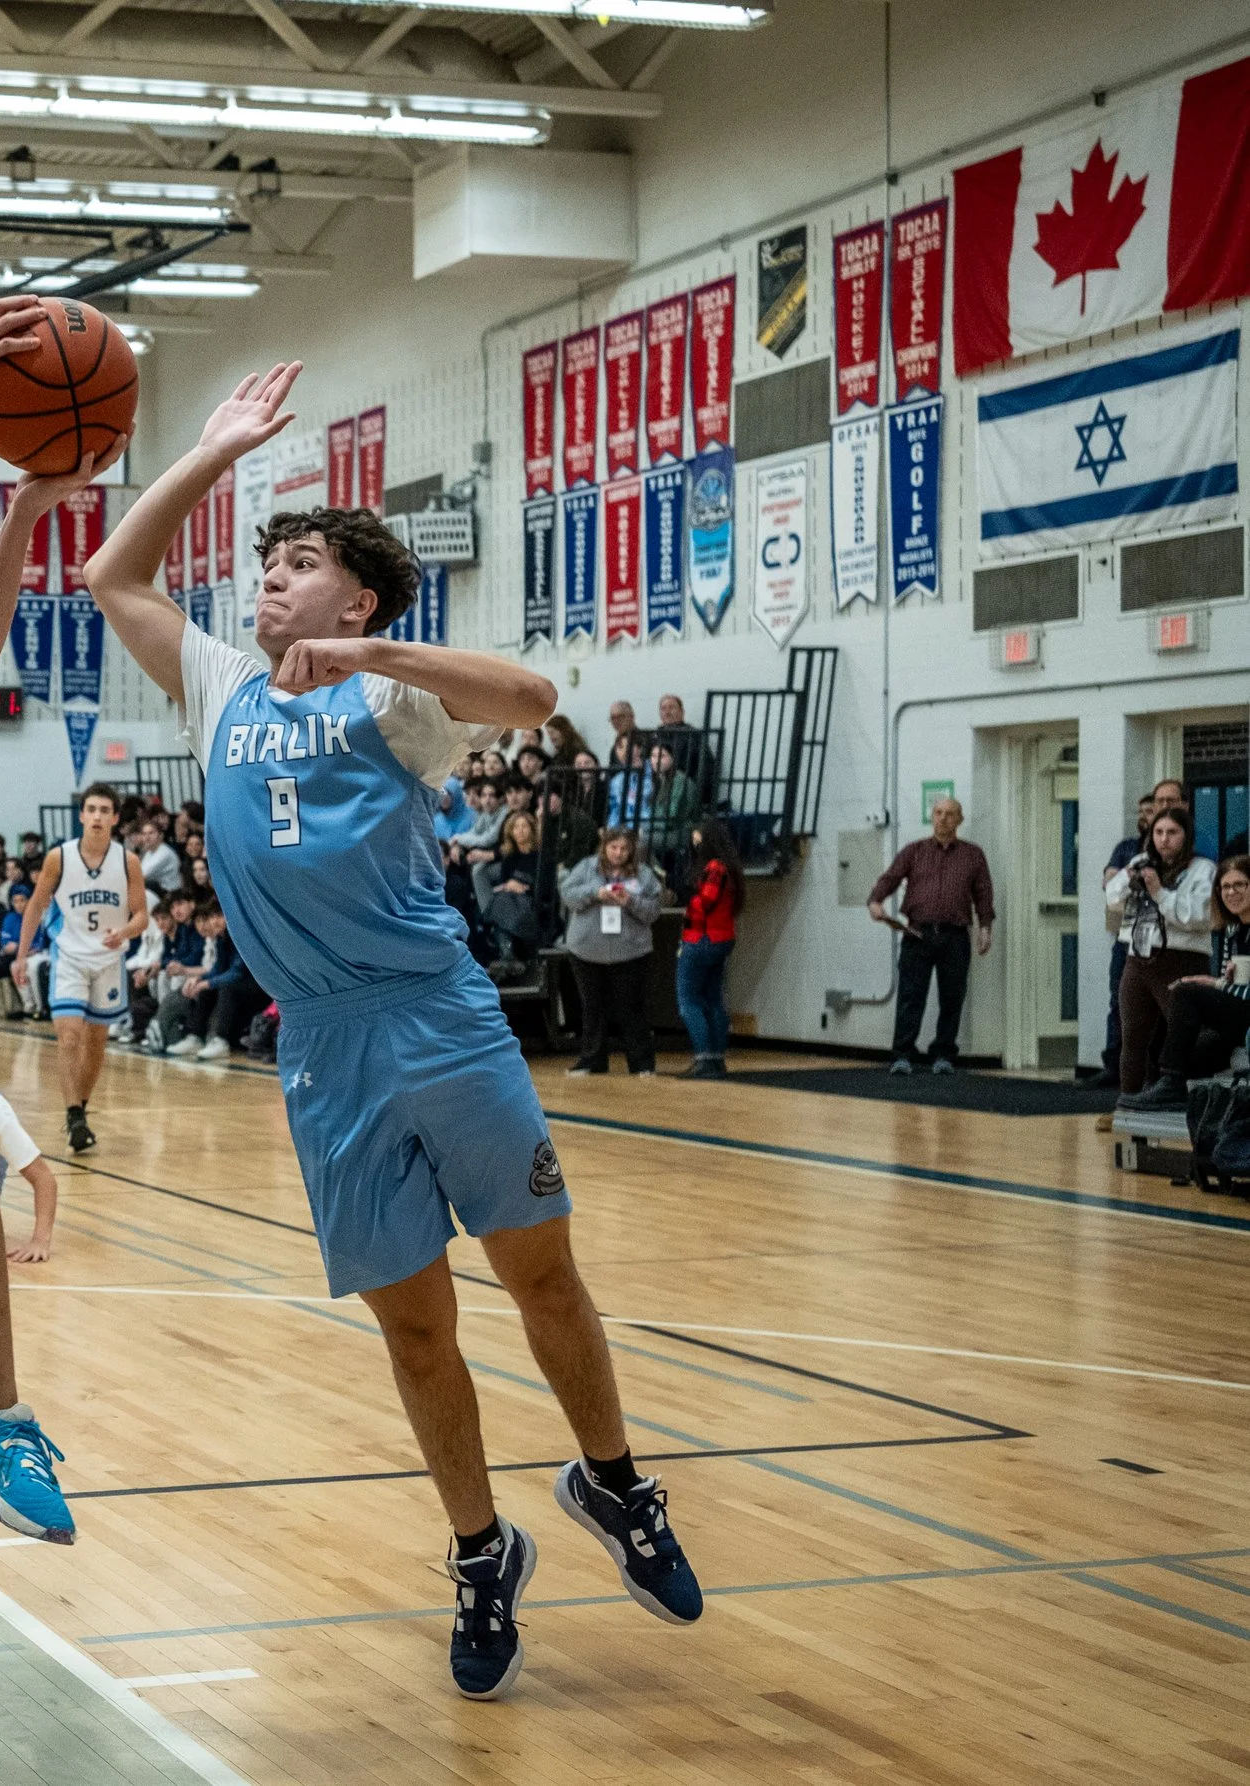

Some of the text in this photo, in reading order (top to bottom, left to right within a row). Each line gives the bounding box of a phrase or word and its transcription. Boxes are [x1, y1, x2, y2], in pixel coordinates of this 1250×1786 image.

[851, 277, 865, 363] HOCKEY
[910, 442, 924, 536] GOLF
[225, 712, 352, 768] BIALIK
[265, 776, 302, 849] 9
[68, 889, 120, 908] TIGERS
[87, 911, 99, 932] 5
